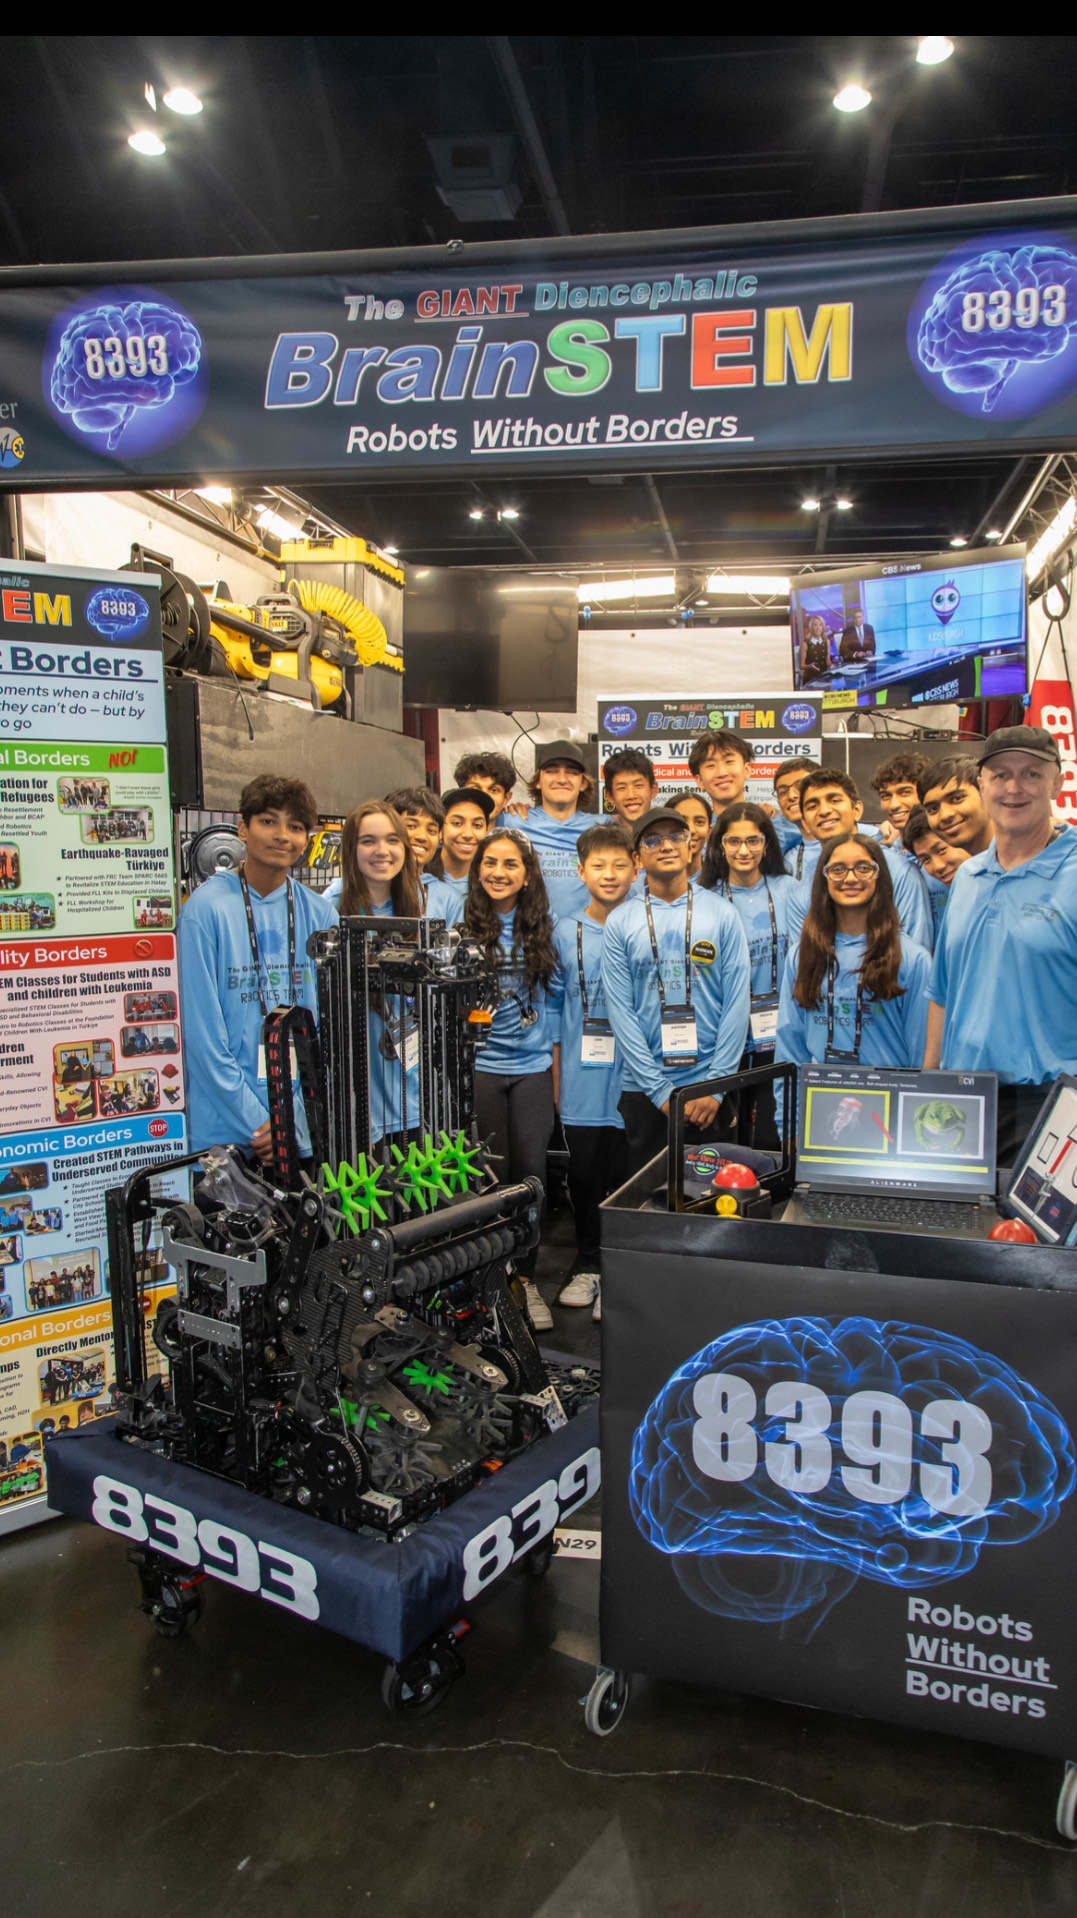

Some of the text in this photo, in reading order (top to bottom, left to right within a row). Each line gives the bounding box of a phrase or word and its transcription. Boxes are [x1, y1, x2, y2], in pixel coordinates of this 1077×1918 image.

[344, 271, 758, 321] The GIANT Diencephalic
[962, 284, 1067, 333] 8393
[83, 335, 169, 380] 8393
[264, 302, 854, 410] BrainSTEM
[346, 411, 738, 454] Robots Without Borders
[882, 563, 922, 575] CBS News
[0, 575, 30, 588] alic
[101, 600, 136, 617] 8393
[10, 646, 144, 677] Borders
[53, 686, 89, 699] when
[92, 690, 100, 699] a
[943, 679, 959, 691] NEWS
[69, 703, 87, 715] do
[103, 704, 126, 716] but
[129, 705, 145, 720] by
[645, 710, 775, 730] BrainSTEM
[14, 719, 32, 731] go
[753, 742, 811, 755] orders
[14, 750, 90, 766] Borders
[108, 748, 137, 768] NO!
[653, 766, 675, 777] dical
[32, 777, 48, 789] for
[0, 791, 55, 804] Refugees
[61, 847, 169, 860] Earthquake-Ravaged
[126, 860, 165, 871] Türkiye
[79, 899, 105, 907] Workshop
[34, 946, 108, 963] Borders
[16, 975, 60, 988] Classes
[62, 974, 77, 985] for
[80, 971, 126, 983] Students
[128, 967, 150, 978] with
[151, 966, 171, 977] ASD
[7, 981, 152, 1001] and children with Leukemia
[53, 1008, 83, 1016] Disabilities
[85, 1014, 114, 1022] Foundation
[4, 1028, 28, 1036] Children
[16, 1071, 41, 1079] Allowing
[20, 1102, 41, 1110] Objects
[0, 1124, 168, 1158] nomic Borders STOP
[53, 1141, 183, 1169] Created STEM Pathways in
[52, 1164, 118, 1182] Underserved
[72, 1178, 109, 1189] Taught Classes
[72, 1185, 106, 1195] Underserved
[73, 1193, 98, 1202] Partnered
[73, 1207, 104, 1216] Established
[76, 1235, 99, 1243] Recruited
[41, 1311, 111, 1336] Borders
[36, 1340, 77, 1358] Directly
[692, 1373, 992, 1516] 8393
[92, 1474, 321, 1621] 8393
[907, 1596, 1034, 1642] Robots
[907, 1633, 1051, 1684] Without
[906, 1669, 1047, 1718] Borders
